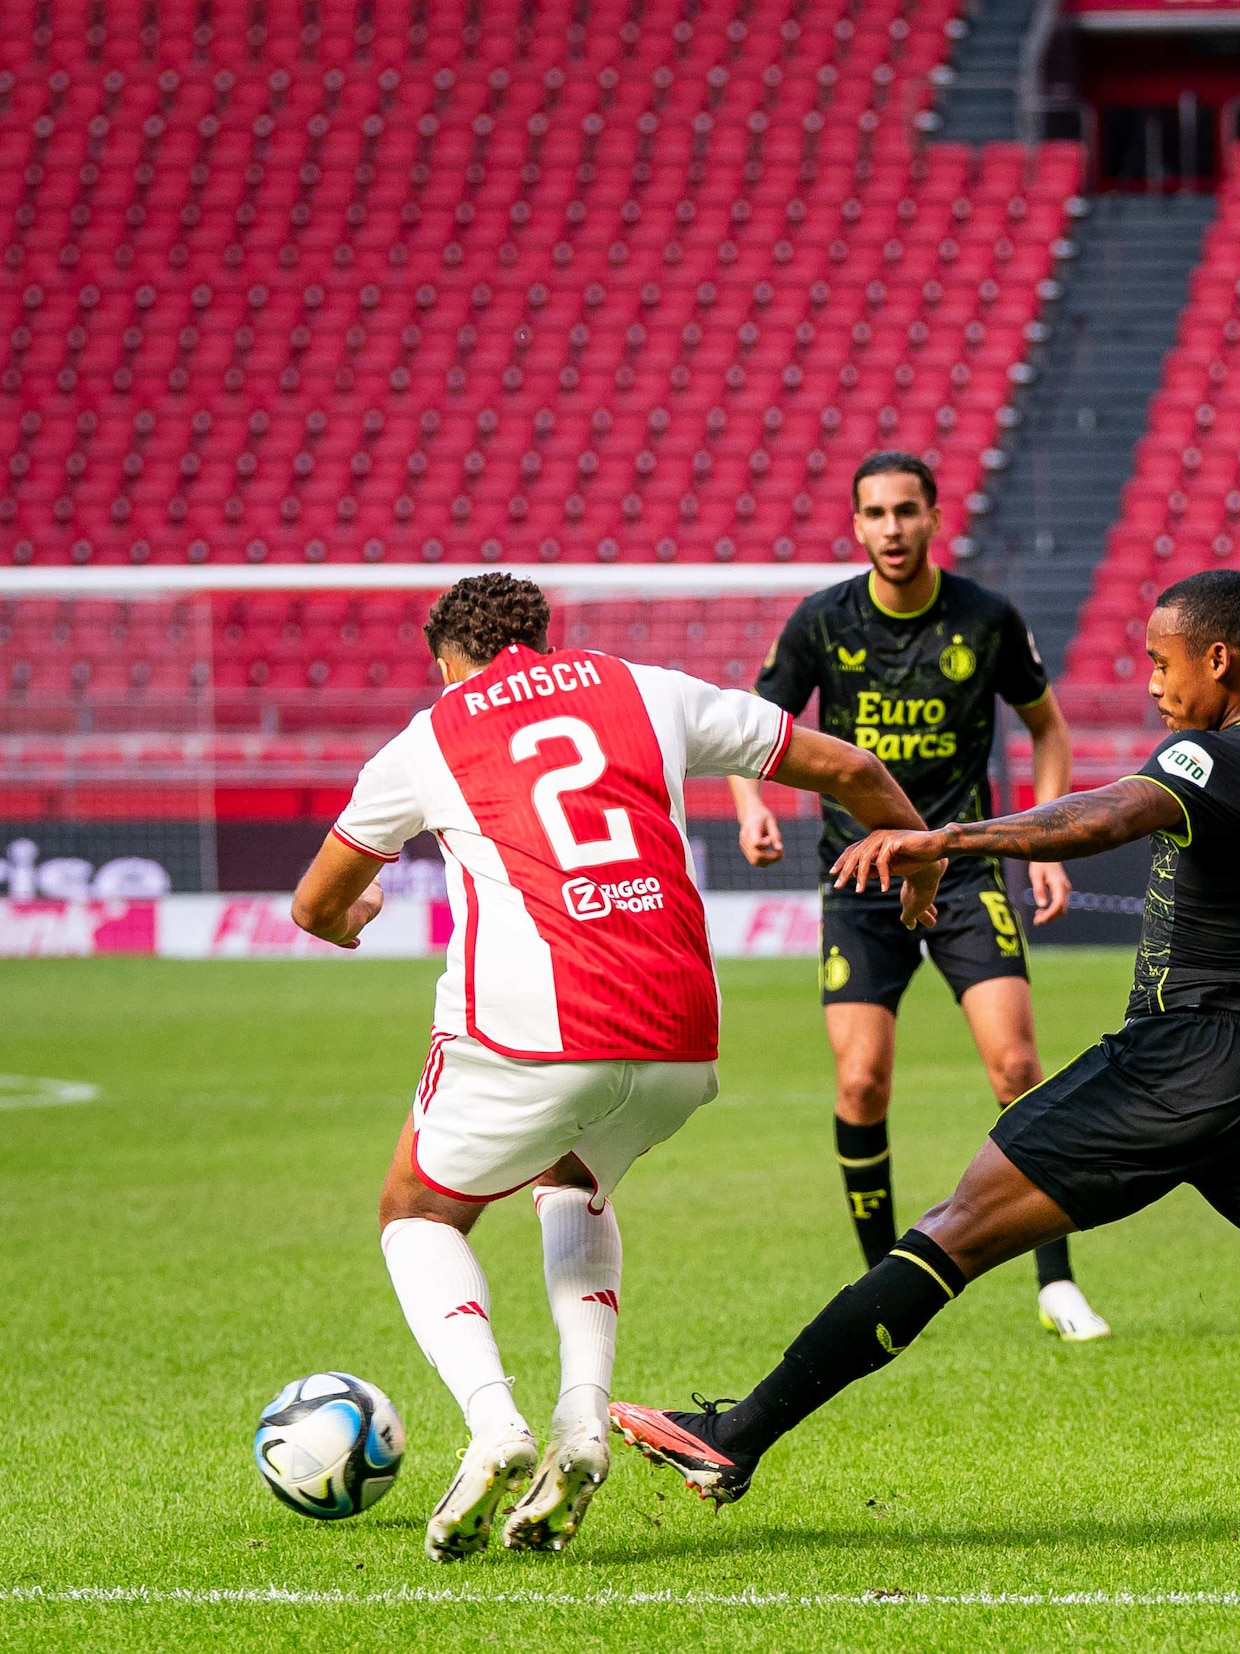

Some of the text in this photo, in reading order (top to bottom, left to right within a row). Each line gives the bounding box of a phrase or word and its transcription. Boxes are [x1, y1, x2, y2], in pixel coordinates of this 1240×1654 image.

[463, 660, 602, 716] RENSCH
[857, 691, 946, 726] Euro
[855, 727, 957, 761] Parcs
[1167, 750, 1204, 780] TOTO
[509, 715, 642, 871] 2
[600, 877, 660, 899] ZIGGO
[850, 1188, 887, 1219] F
